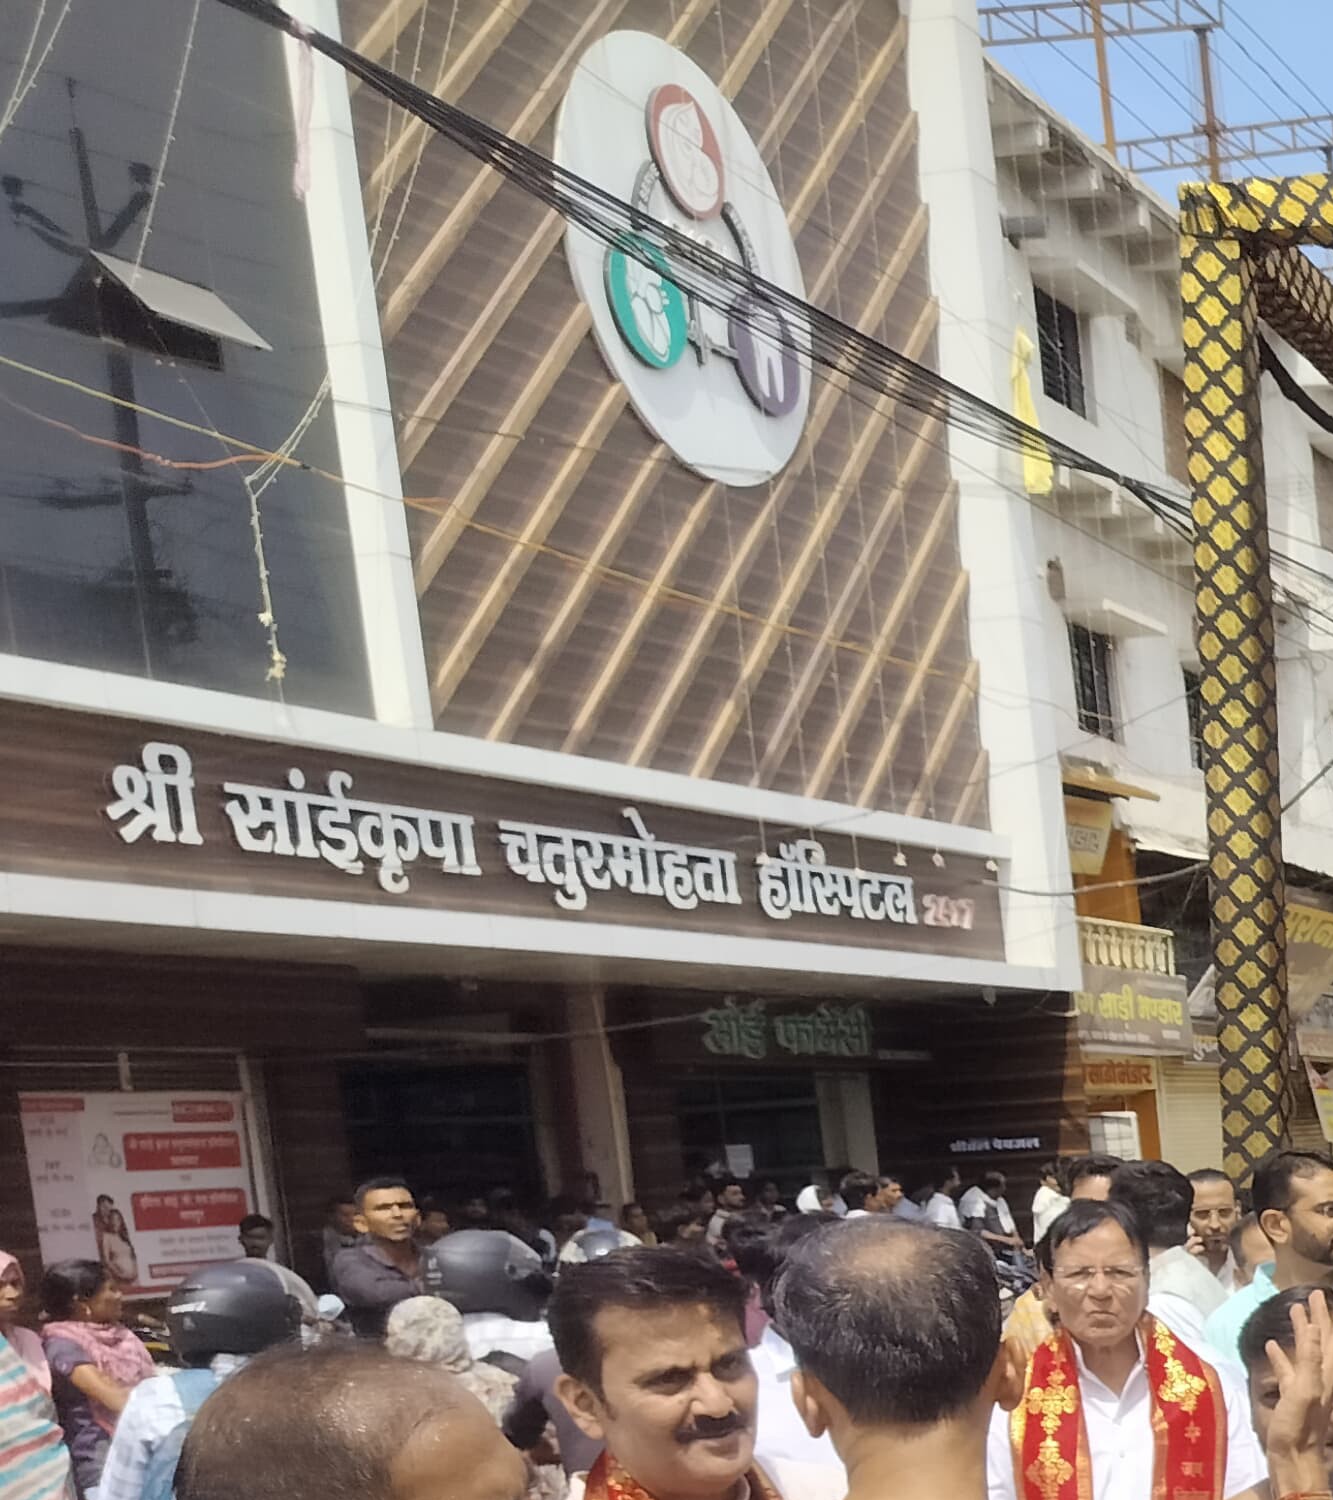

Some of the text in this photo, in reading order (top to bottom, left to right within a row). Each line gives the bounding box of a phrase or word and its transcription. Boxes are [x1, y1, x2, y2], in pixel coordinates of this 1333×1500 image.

[105, 741, 203, 845] श्री
[498, 808, 742, 910] चतुरमोहता
[757, 839, 918, 924] हॉस्पिटल
